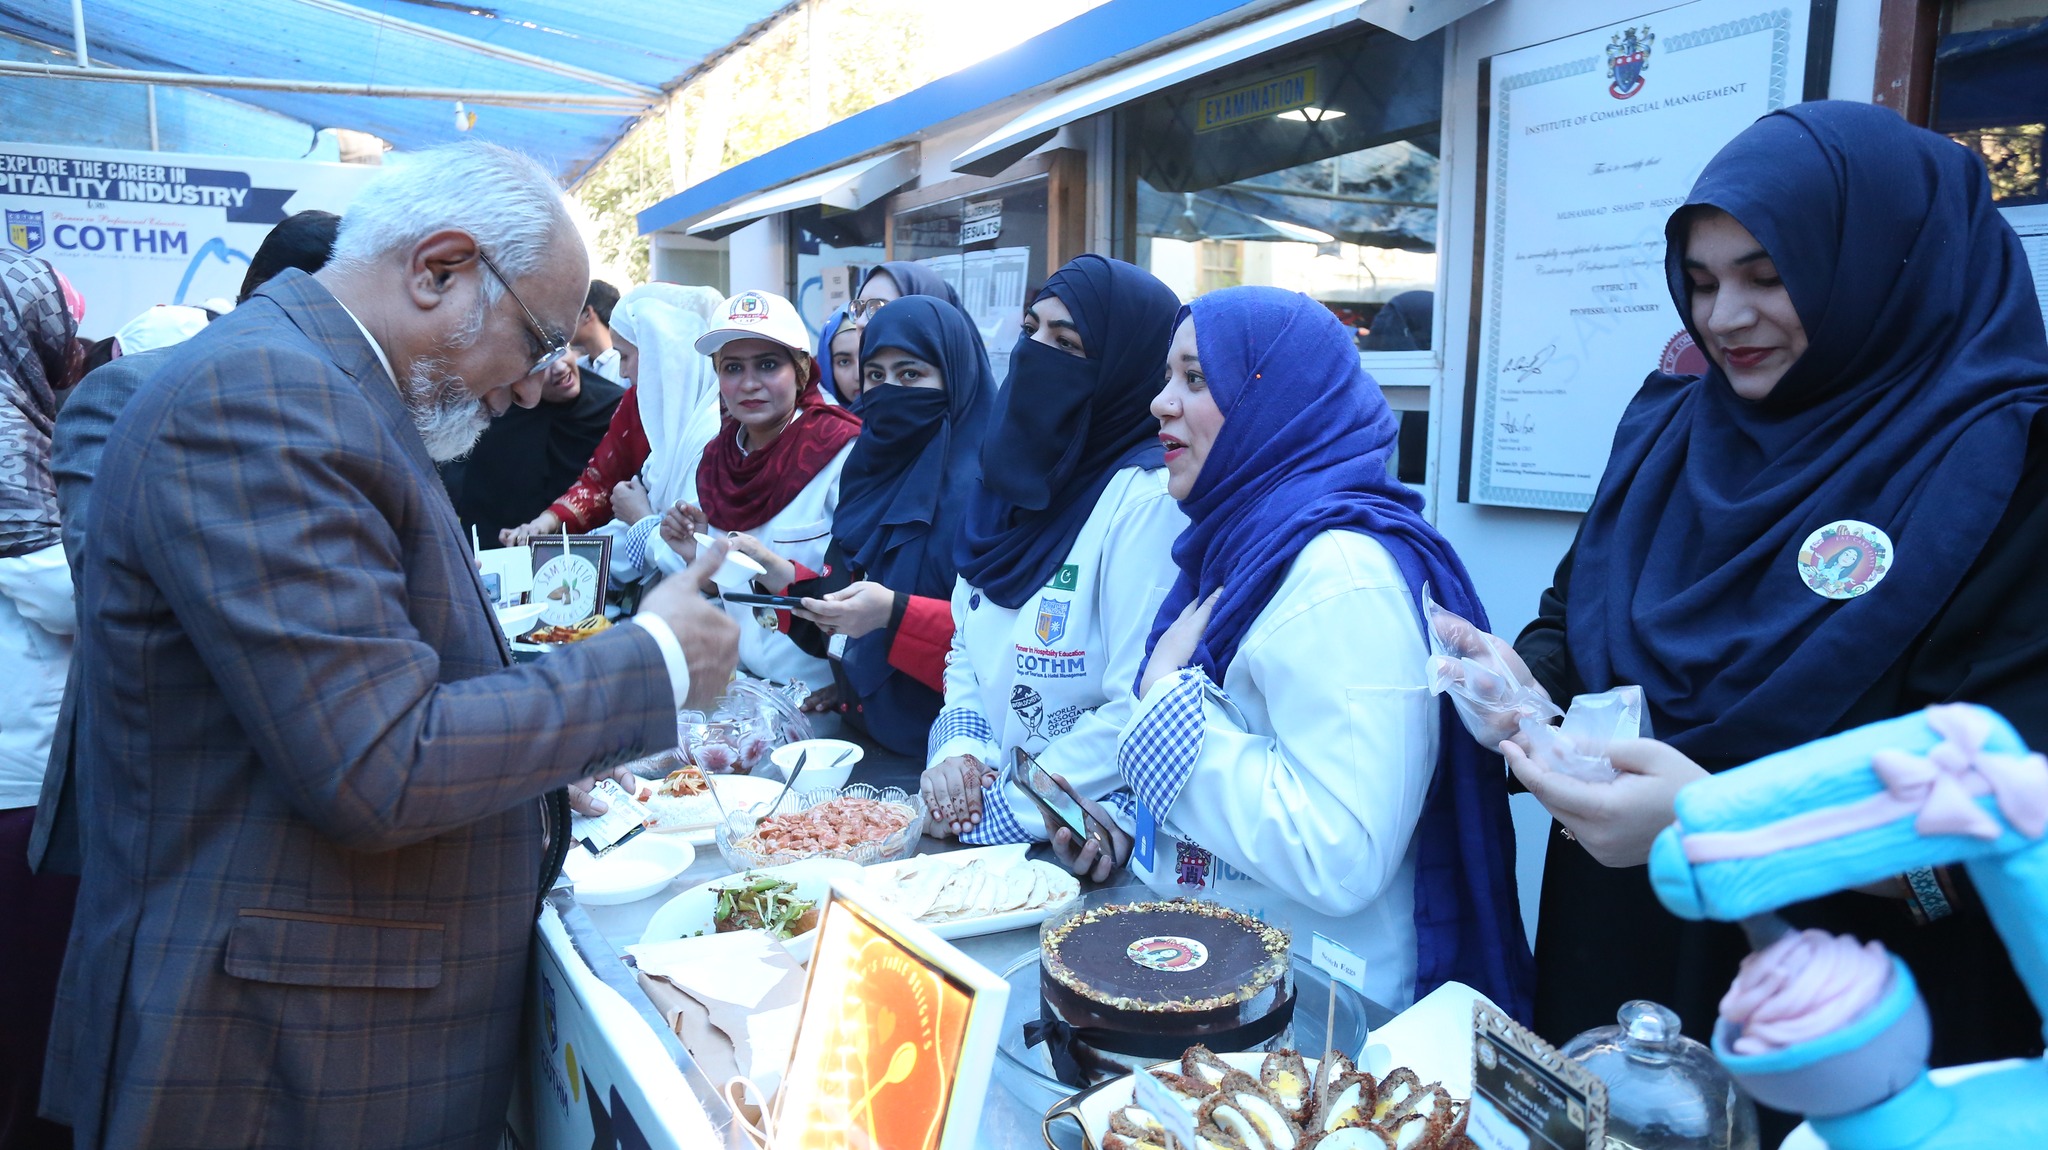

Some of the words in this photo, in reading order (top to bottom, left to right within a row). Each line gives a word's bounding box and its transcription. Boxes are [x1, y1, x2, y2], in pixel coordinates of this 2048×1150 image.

[1205, 76, 1305, 125] EXAMINATION
[1525, 119, 1572, 136] INSTITUTE
[1574, 115, 1588, 126] OF
[1590, 101, 1660, 123] COMMERCIAL
[1663, 83, 1747, 108] MANAGEMENT
[72, 160, 103, 178] THE
[106, 163, 166, 182] CAREER
[170, 167, 187, 184] IN
[119, 181, 248, 208] INDUSTRY
[53, 224, 188, 254] COTHM
[963, 221, 999, 240] RESULTS
[1592, 282, 1638, 293] CERTIFICTE
[1016, 654, 1085, 673] COTHM
[1047, 705, 1076, 719] WORLD
[1048, 722, 1060, 731] OF
[1321, 951, 1339, 969] Scotch
[1340, 963, 1356, 977] Eggs
